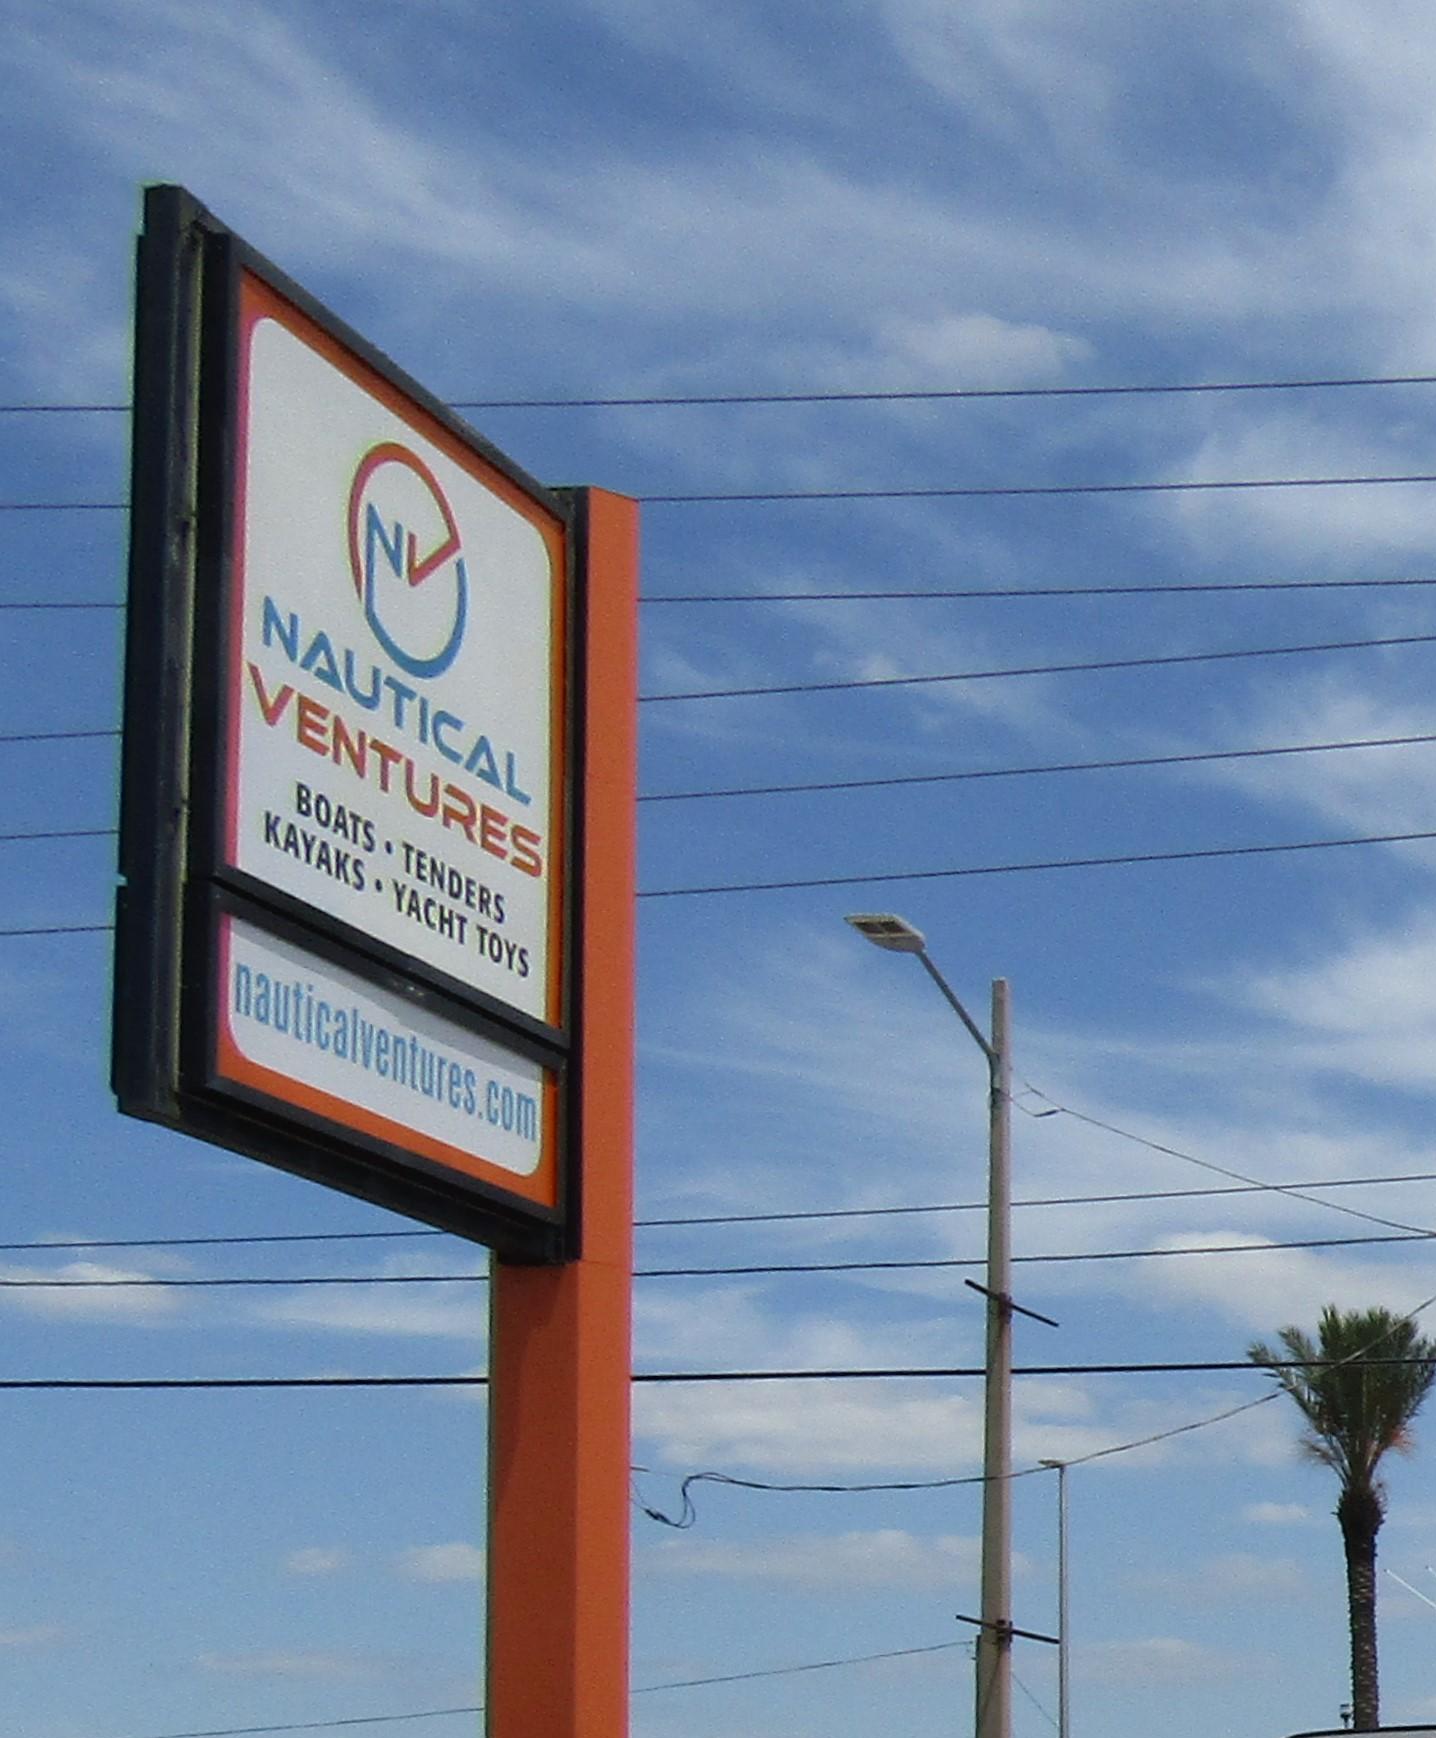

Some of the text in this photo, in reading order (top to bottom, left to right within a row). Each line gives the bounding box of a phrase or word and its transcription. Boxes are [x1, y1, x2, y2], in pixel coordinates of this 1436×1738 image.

[247, 661, 542, 878] VENTURES
[262, 595, 532, 806] NAUTICAL
[264, 810, 529, 978] KAYAKS YACHT TOYS
[296, 781, 505, 925] BOATS TENDERS
[235, 962, 537, 1143] nauticalventures.com
